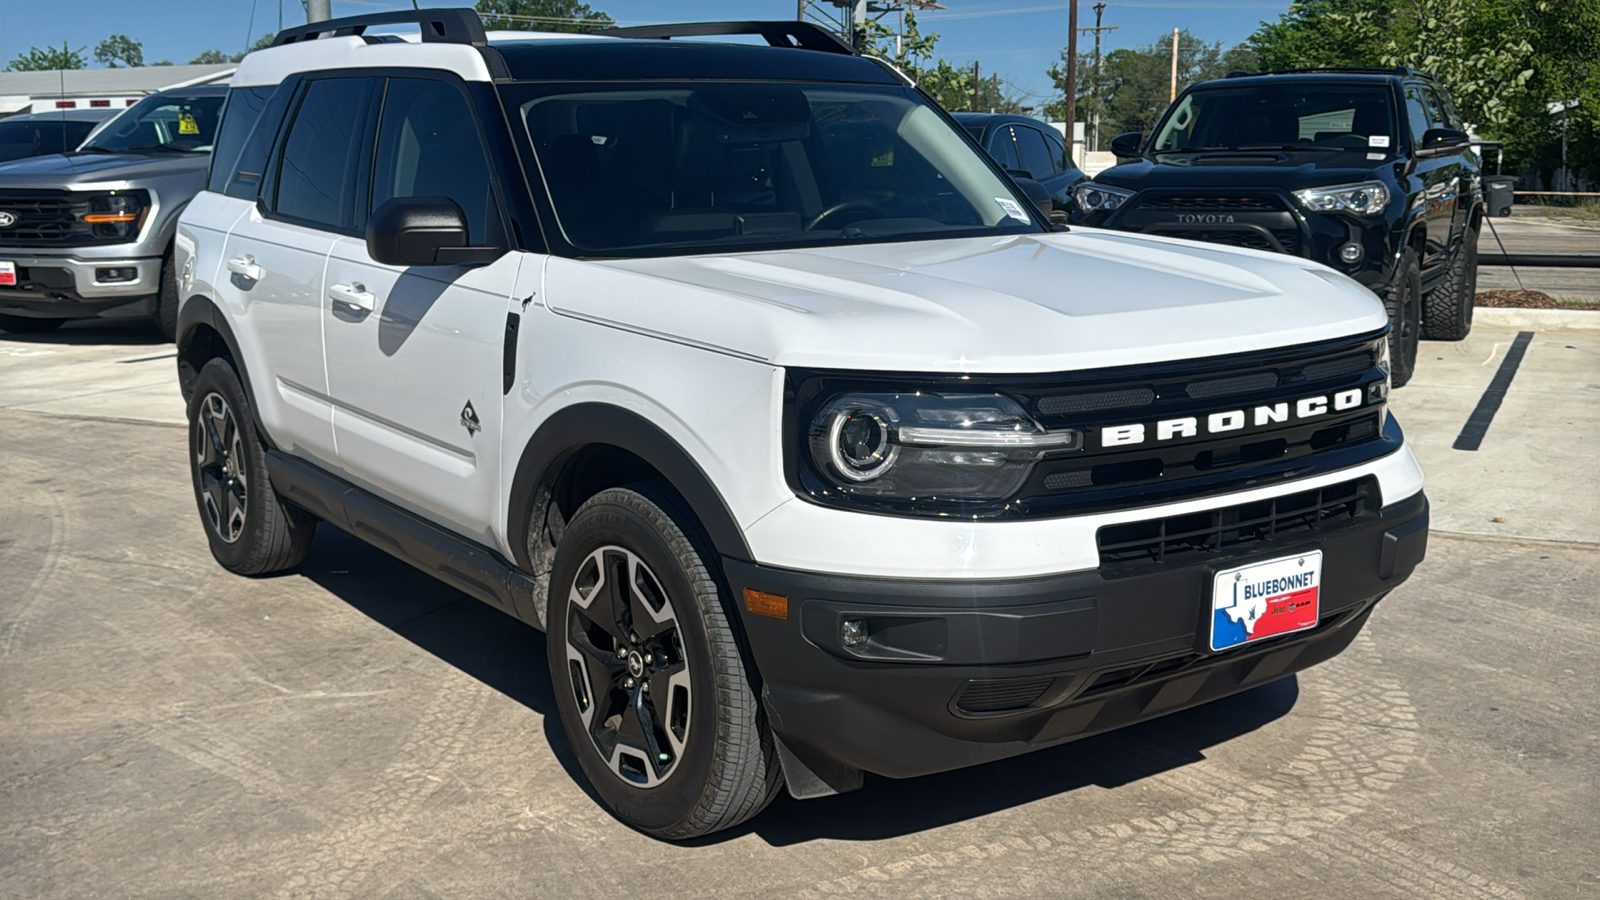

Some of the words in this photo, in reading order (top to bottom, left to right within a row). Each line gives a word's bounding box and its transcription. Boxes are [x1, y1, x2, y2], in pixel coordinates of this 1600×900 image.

[1177, 214, 1234, 223] TOYOTA
[1101, 388, 1362, 448] BRONCO
[1244, 571, 1314, 600] BLUEBONNET
